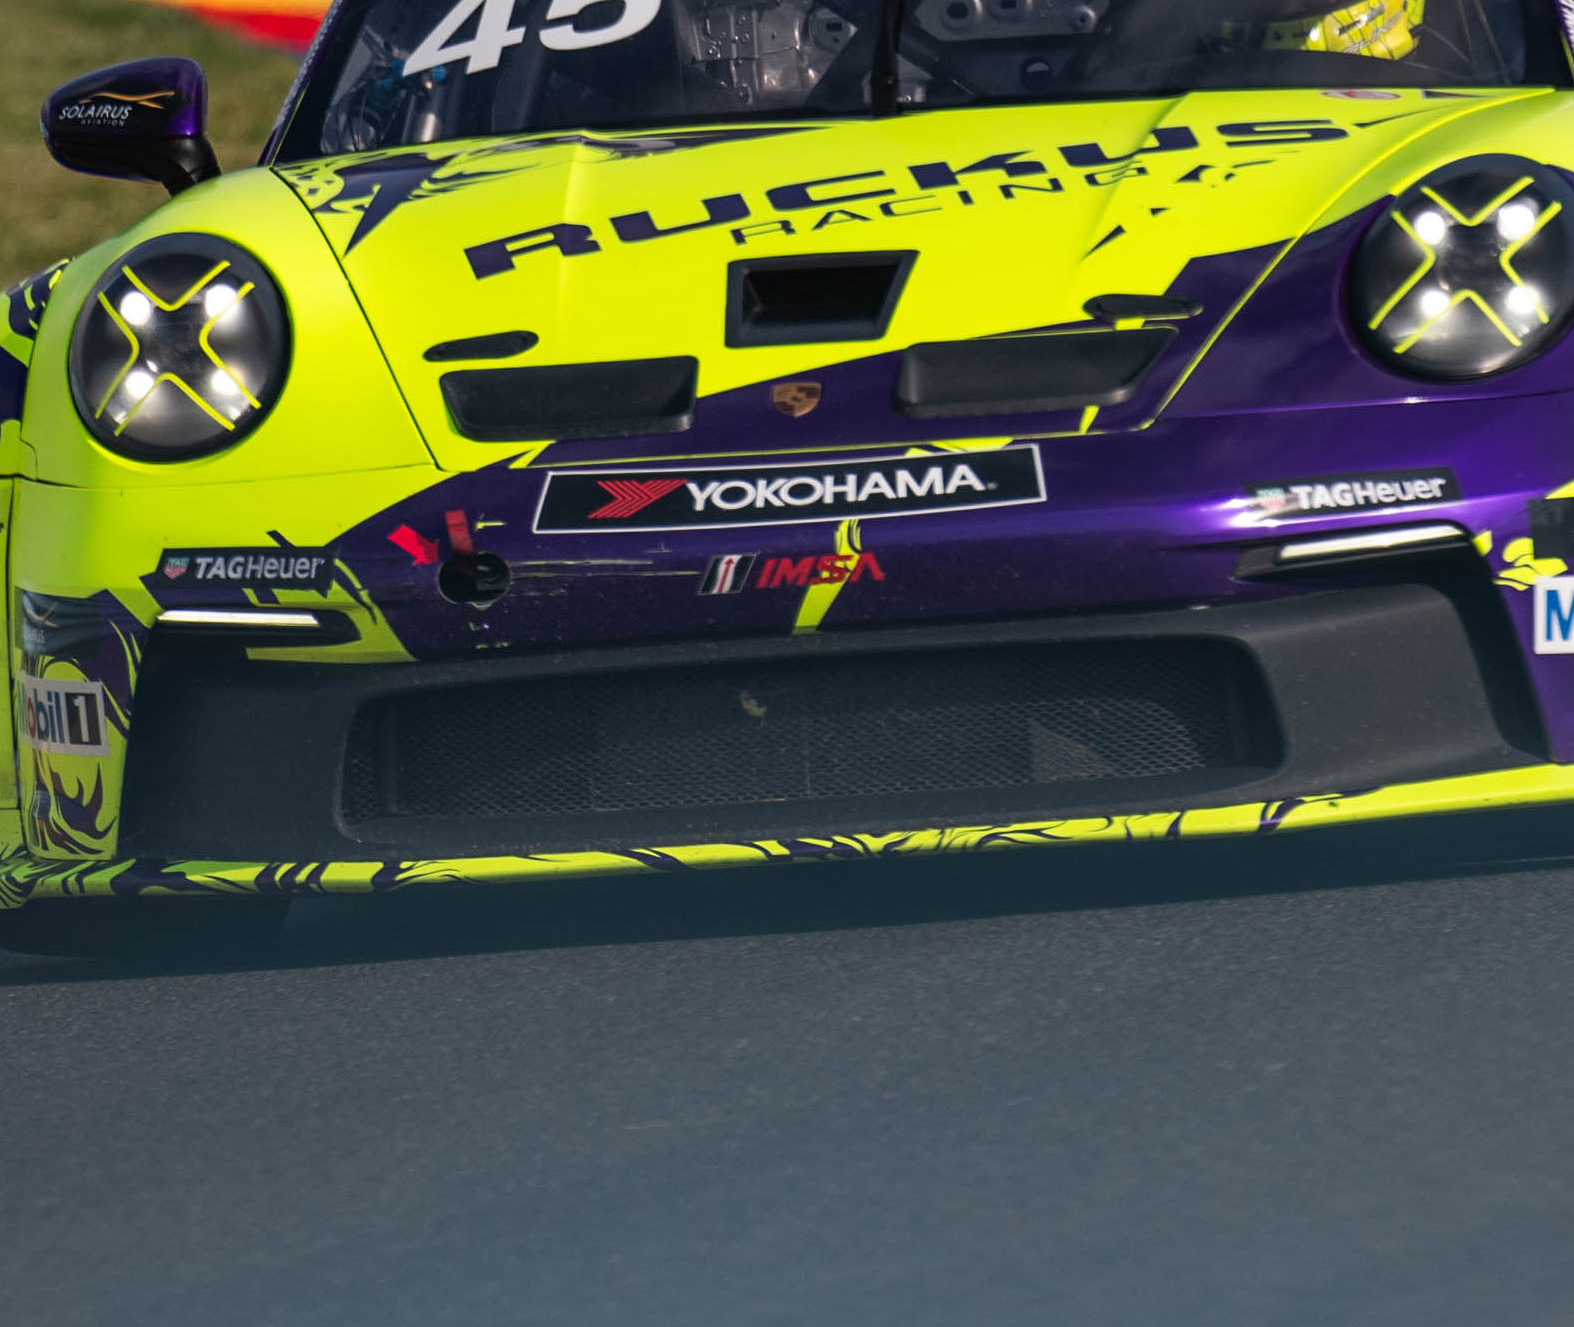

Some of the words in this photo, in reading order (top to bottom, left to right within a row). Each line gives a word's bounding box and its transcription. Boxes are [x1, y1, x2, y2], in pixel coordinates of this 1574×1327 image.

[59, 103, 132, 120] SOLAIRUS
[463, 119, 1349, 280] RUCKUS
[729, 160, 1150, 245] RACING
[685, 463, 988, 512] YOKOHAMA
[755, 552, 885, 589] IMSA
